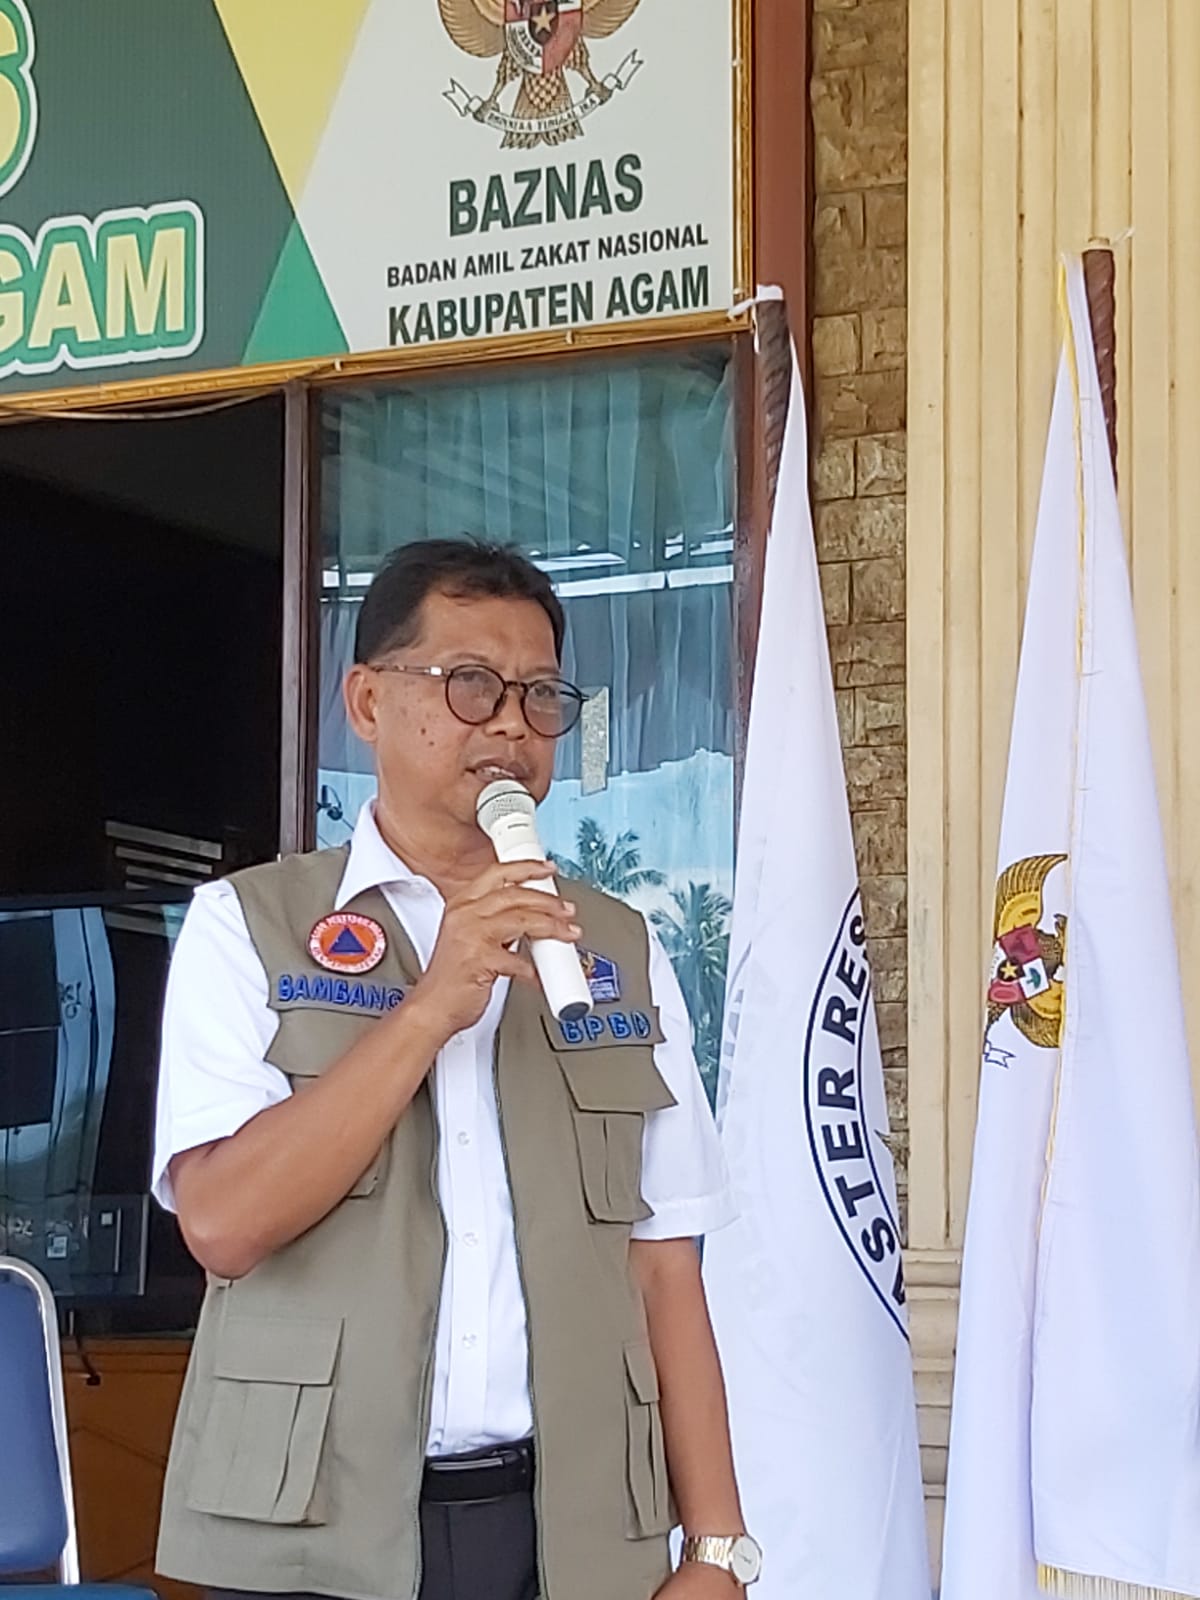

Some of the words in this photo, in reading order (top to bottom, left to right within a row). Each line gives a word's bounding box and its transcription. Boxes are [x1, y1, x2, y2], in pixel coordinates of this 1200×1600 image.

[449, 153, 643, 237] BAZNAS
[387, 258, 456, 288] BADAN
[463, 250, 514, 279] AMIL
[520, 239, 591, 270] ZAKAT
[598, 223, 708, 260] NASIONAL
[388, 280, 593, 346] KABUPATEN
[606, 265, 709, 318] AGAM
[560, 1011, 651, 1044] BPBD
